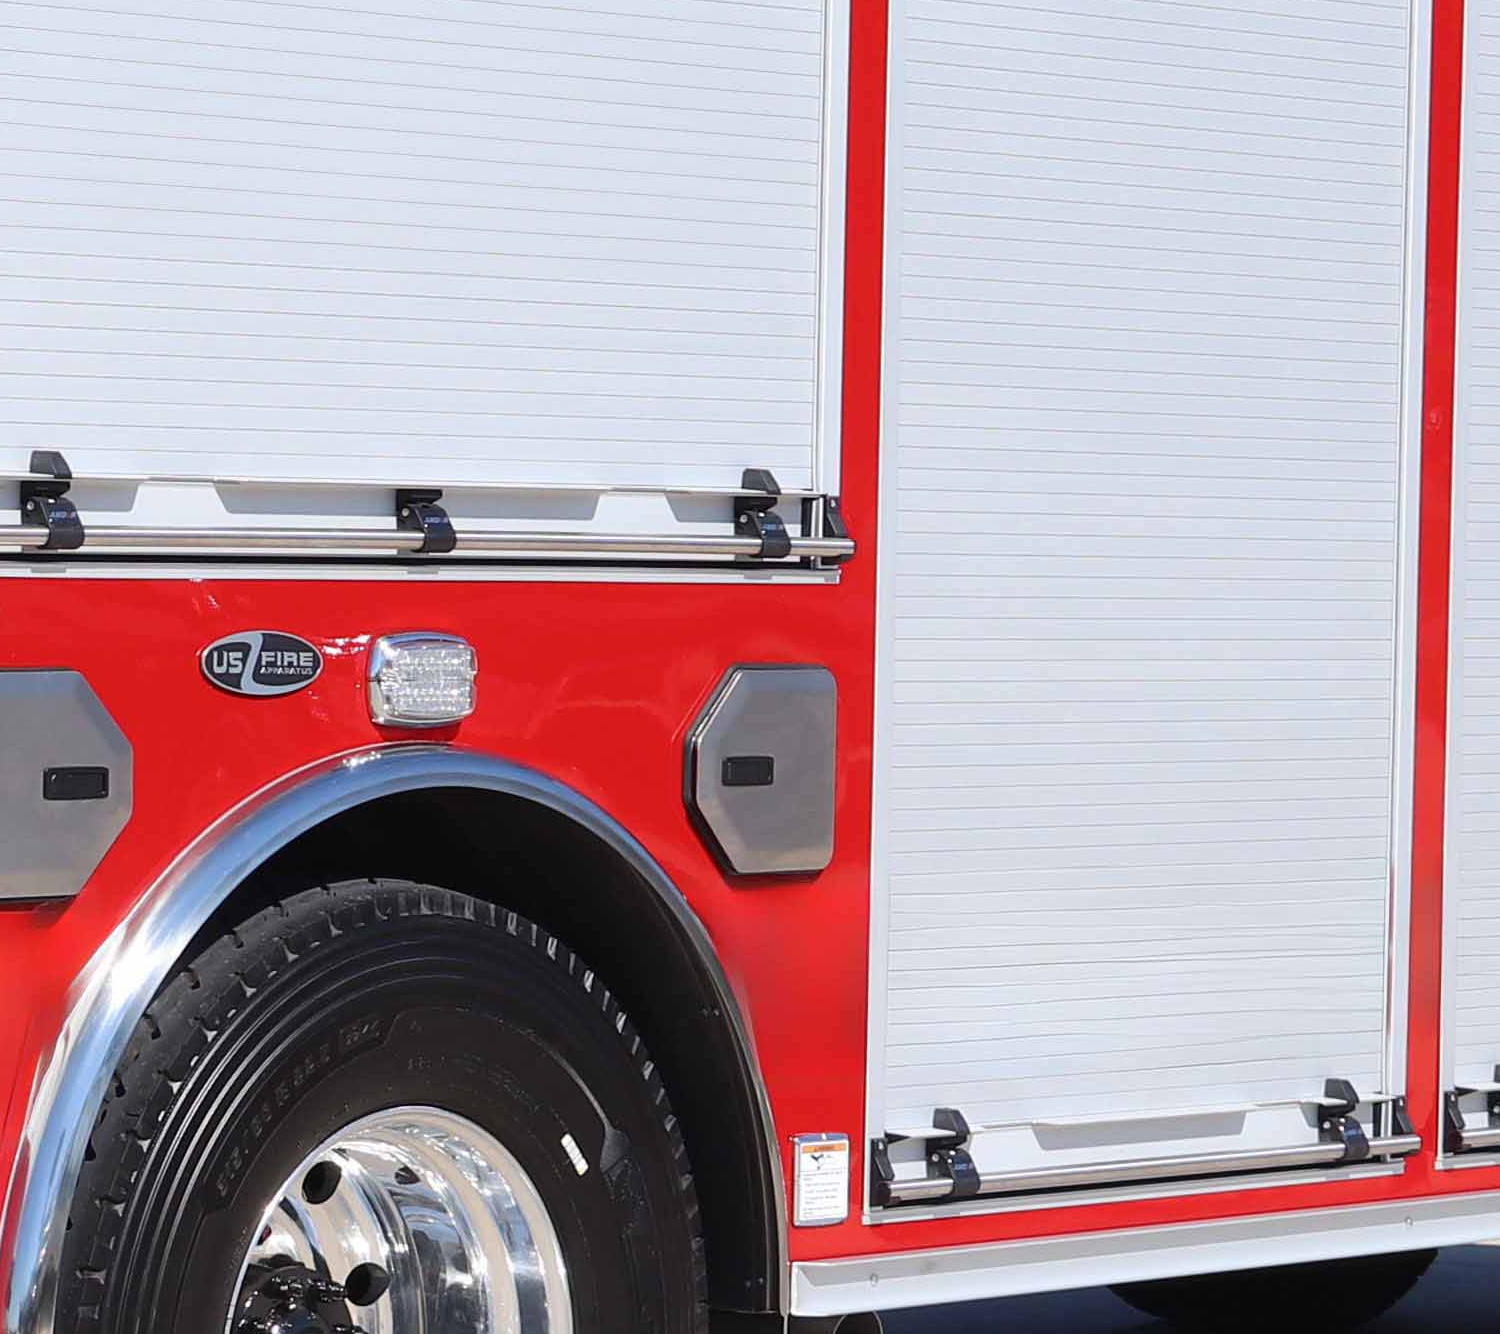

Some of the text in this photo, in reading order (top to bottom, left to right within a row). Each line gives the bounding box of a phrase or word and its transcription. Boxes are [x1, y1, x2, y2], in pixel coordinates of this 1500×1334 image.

[213, 651, 243, 674] US
[261, 651, 314, 667] FIRE
[260, 667, 313, 675] APPARATUS
